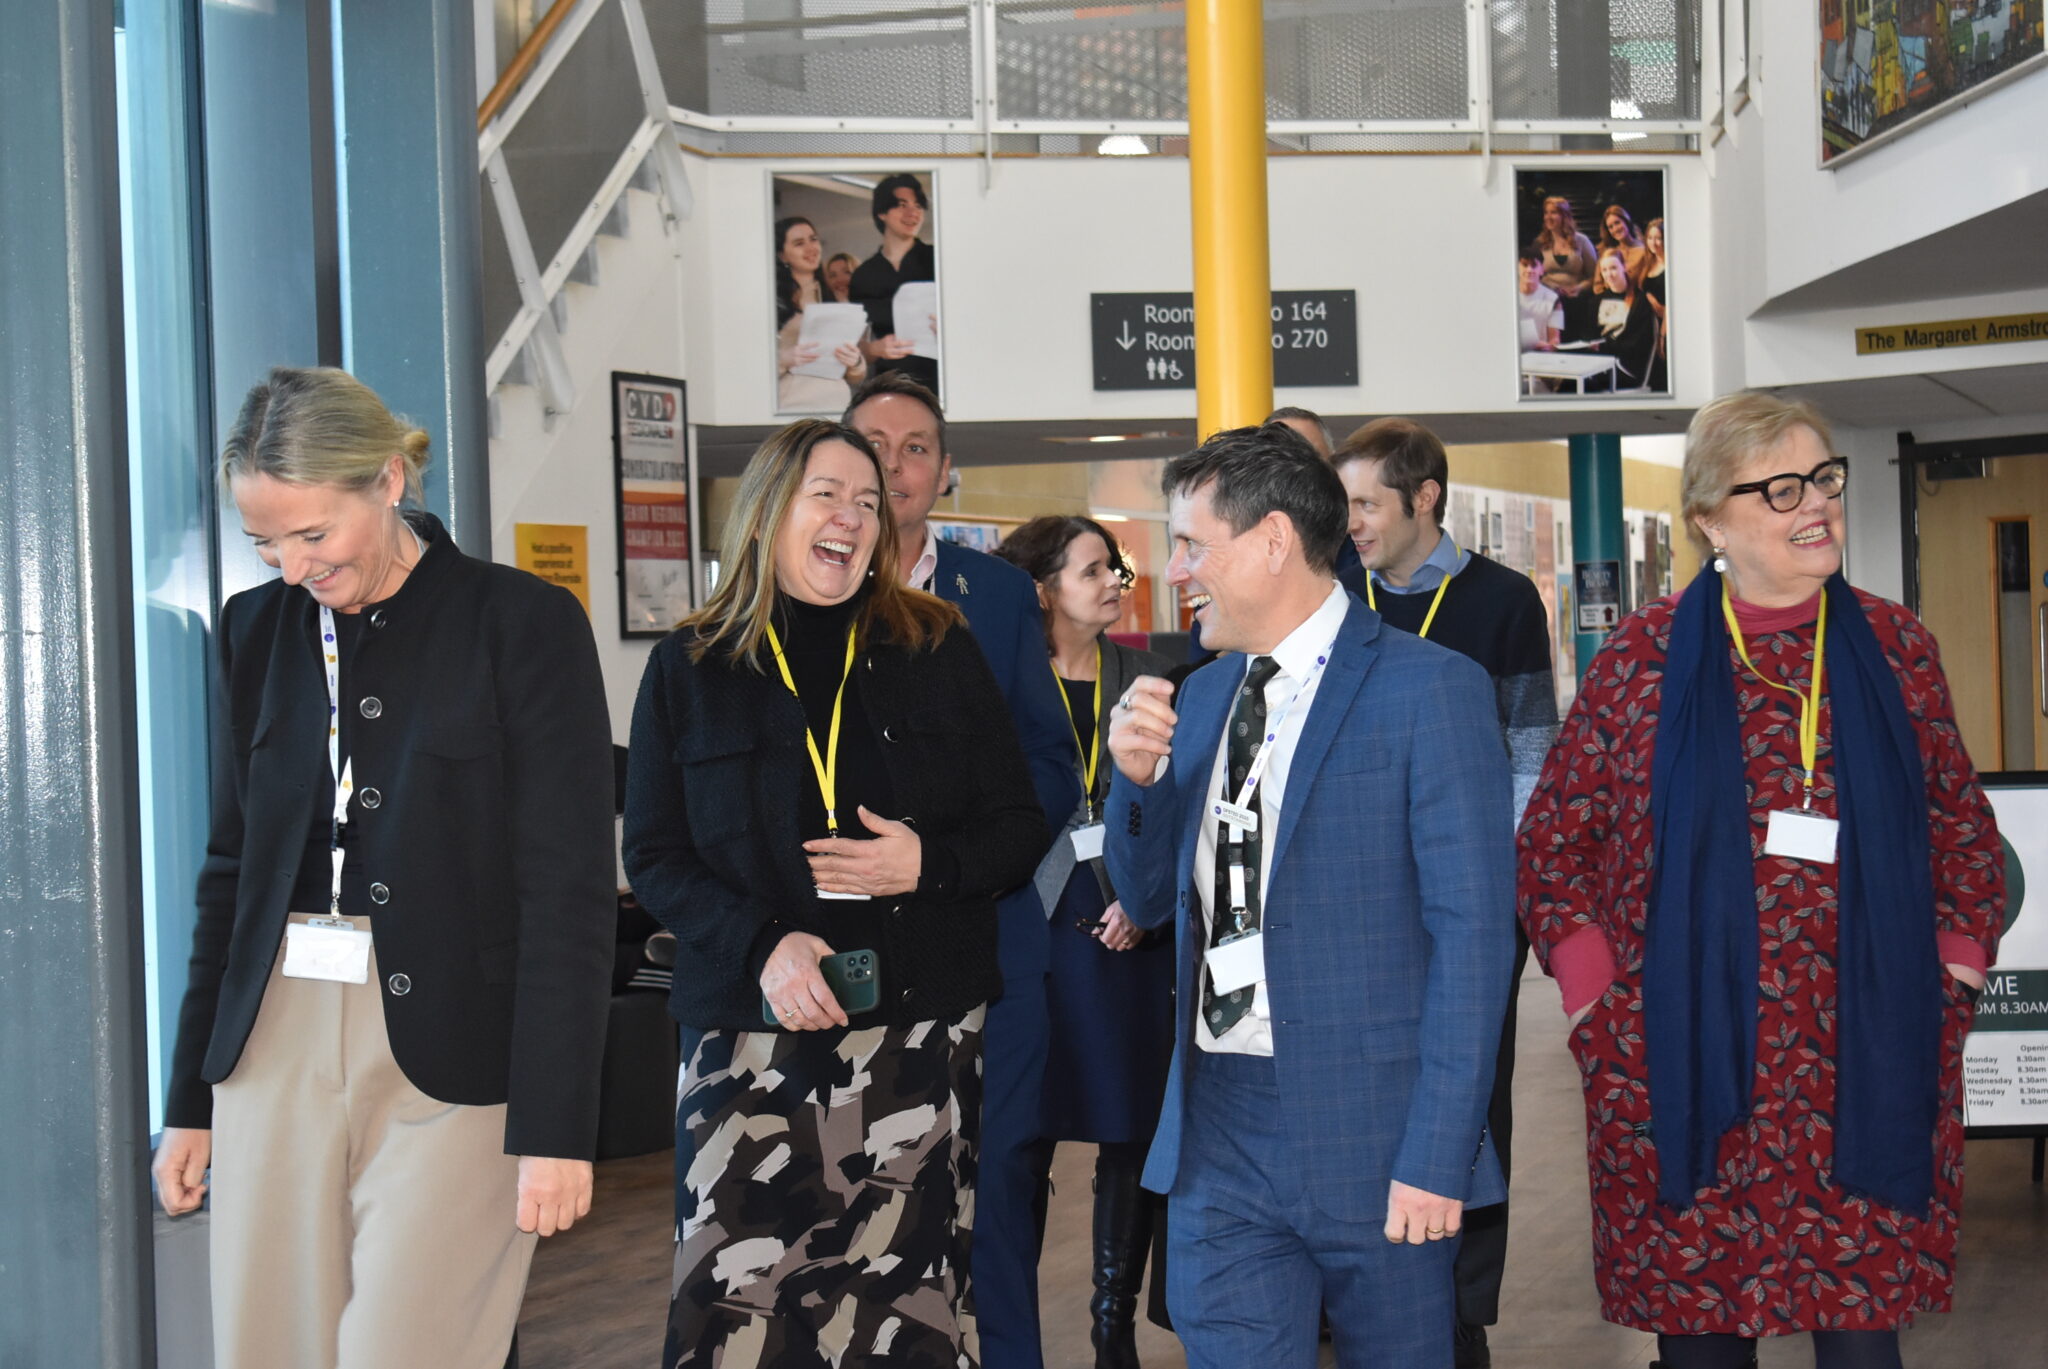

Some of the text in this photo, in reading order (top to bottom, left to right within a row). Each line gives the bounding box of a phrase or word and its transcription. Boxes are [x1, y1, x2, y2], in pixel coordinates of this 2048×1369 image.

[1291, 302, 1327, 321] 164
[1291, 329, 1328, 349] 270
[1864, 332, 1895, 350] The
[1904, 324, 1978, 348] Margaret
[1984, 976, 2019, 996] ME
[2000, 1001, 2048, 1014] 8.30AM
[1965, 1056, 1998, 1064] Monday
[1966, 1067, 1999, 1075] Tuesday
[1966, 1077, 2012, 1085] Wednesday
[1968, 1088, 2005, 1096] Thursday
[1969, 1099, 1993, 1107] Friday
